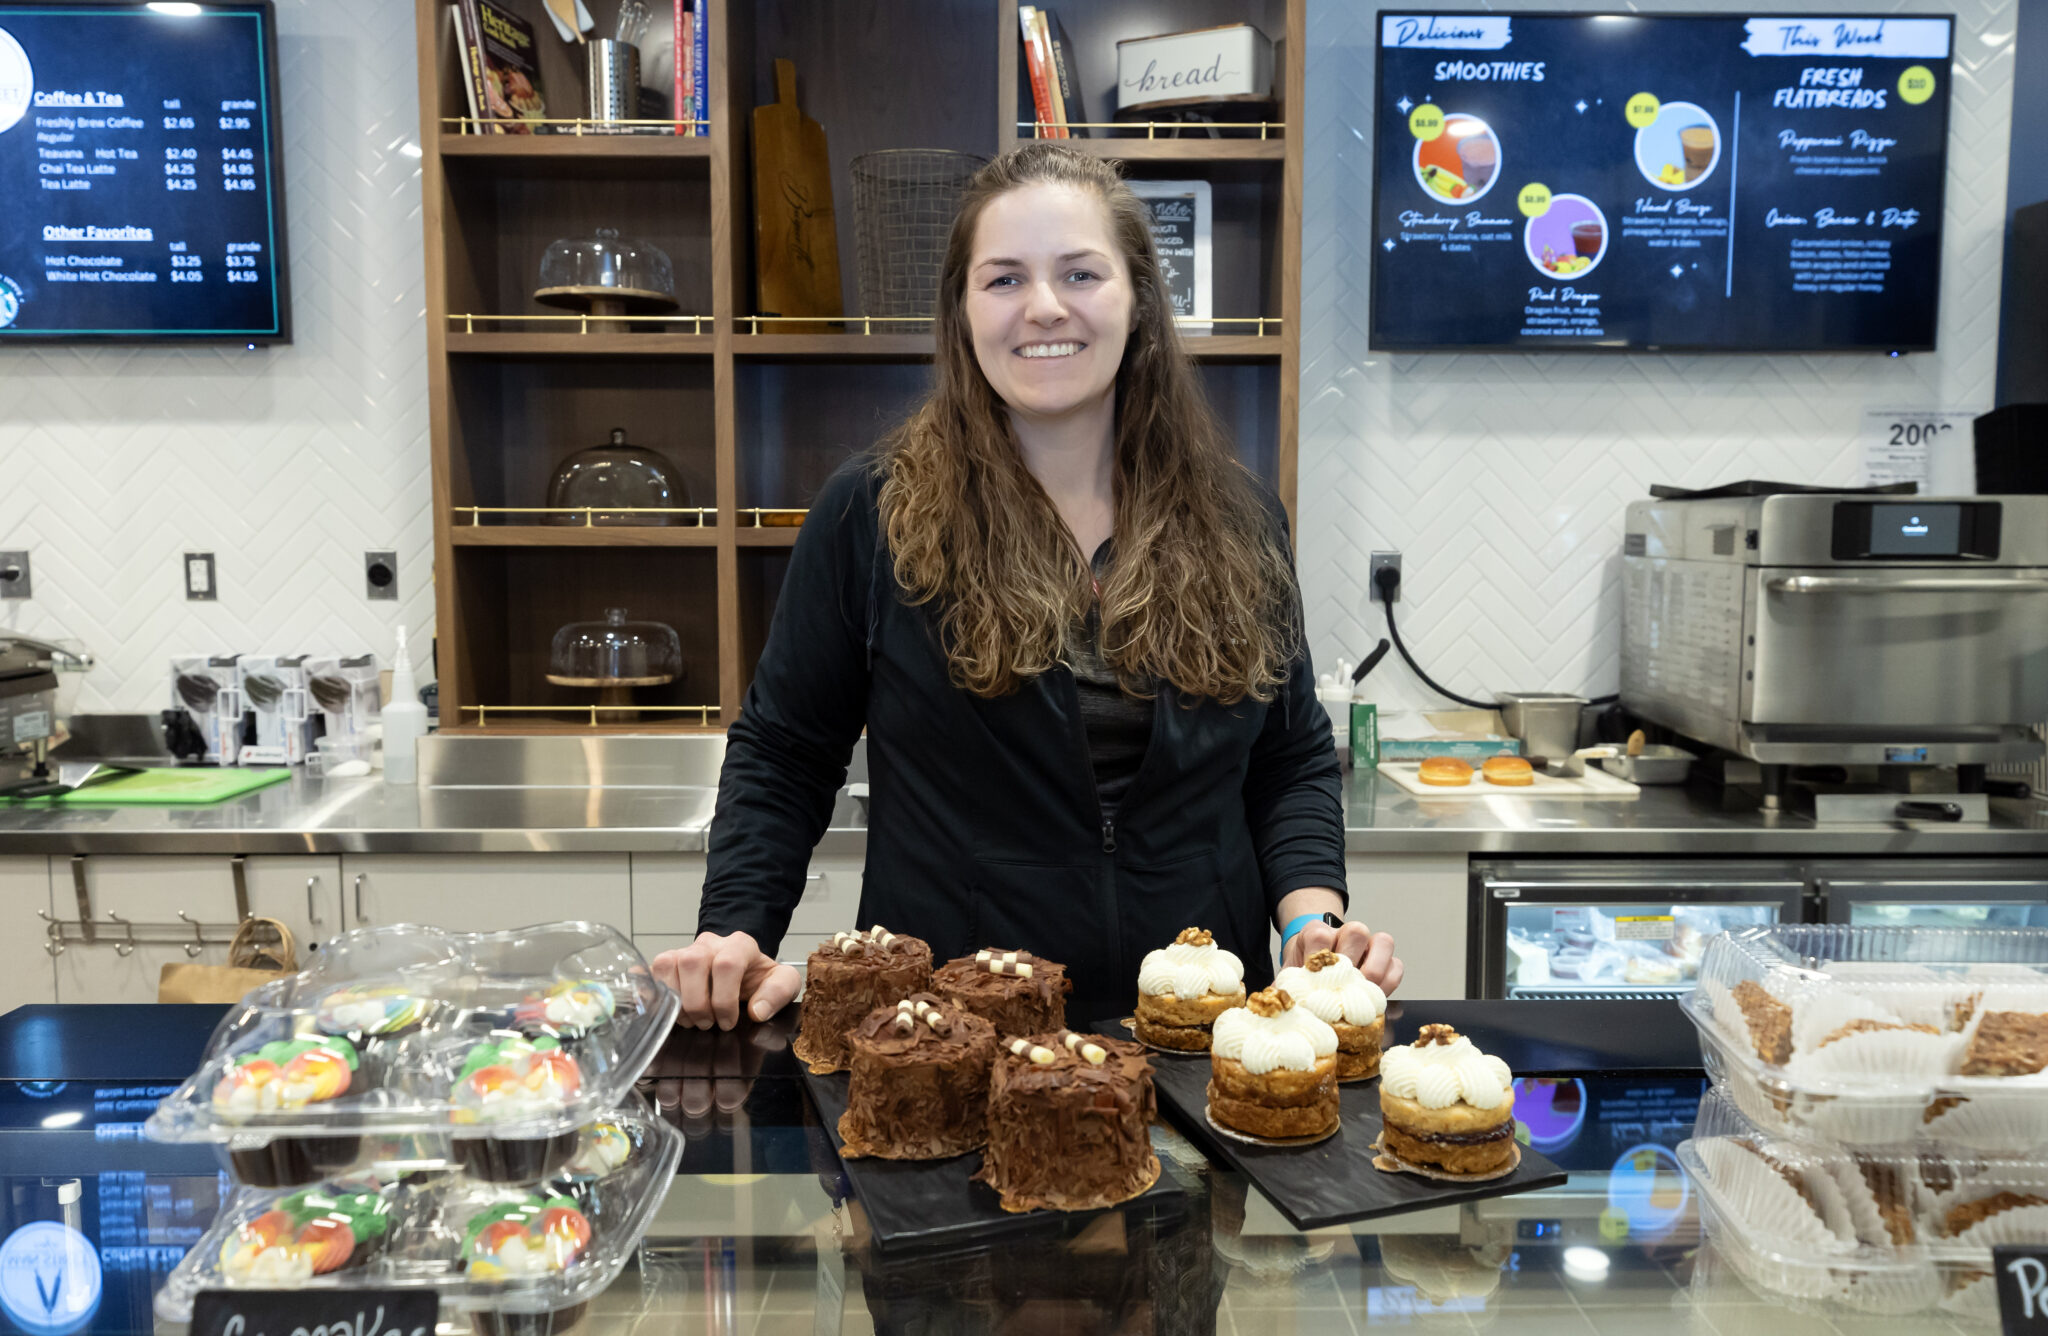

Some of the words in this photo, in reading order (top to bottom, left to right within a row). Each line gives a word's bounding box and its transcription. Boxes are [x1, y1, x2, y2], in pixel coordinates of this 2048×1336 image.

[1396, 16, 1485, 46] Delicious
[1779, 24, 1822, 51] This
[1834, 19, 1885, 49] Week
[1124, 53, 1240, 92] bread
[1434, 59, 1546, 82] SMOOTHIES
[1800, 67, 1864, 88] FRESH
[34, 91, 83, 106] Coffee
[84, 91, 96, 105] &
[96, 91, 124, 106] Tea
[163, 98, 181, 110] tall
[221, 99, 257, 112] grande
[1773, 87, 1888, 109] FLATBREADS
[36, 116, 76, 130] Freshly
[77, 116, 105, 128] Brew
[106, 116, 144, 128] Coffee
[163, 116, 195, 130] $2.65
[219, 116, 251, 130] $2.95
[37, 132, 74, 144] Regular
[1777, 128, 1843, 152] Pepperoni
[1849, 128, 1897, 153] Pizza
[39, 148, 84, 159] Teavana
[95, 148, 116, 159] Hot
[117, 148, 138, 159] Tea
[165, 147, 198, 160] $2.40
[222, 147, 253, 160] $4.45
[39, 163, 64, 174] Chai
[65, 163, 85, 174] Tea
[86, 163, 116, 174] Latte
[164, 163, 196, 176] $4.25
[222, 163, 254, 176] $4.95
[40, 178, 60, 190] Tea
[61, 178, 91, 190] Latte
[166, 178, 197, 191] $4.25
[224, 178, 256, 191] $4.95
[1399, 210, 1460, 231] Strawberry
[1465, 211, 1514, 228] Banana
[1814, 207, 1860, 229] Bacon
[43, 225, 85, 240] Other
[86, 225, 154, 241] Favorites
[169, 241, 187, 252] tall
[226, 241, 262, 254] grande
[45, 255, 66, 267] Hot
[67, 255, 123, 267] Chocolate
[170, 255, 202, 268] $3.25
[225, 255, 256, 268] $3.75
[46, 271, 78, 282] White
[79, 271, 100, 282] Hot
[101, 271, 157, 282] Chocolate
[170, 270, 203, 283] $4.05
[227, 270, 258, 283] $4.55
[1528, 286, 1557, 302] Pink
[1561, 286, 1601, 306] Dragon
[1889, 423, 1953, 446] 200
